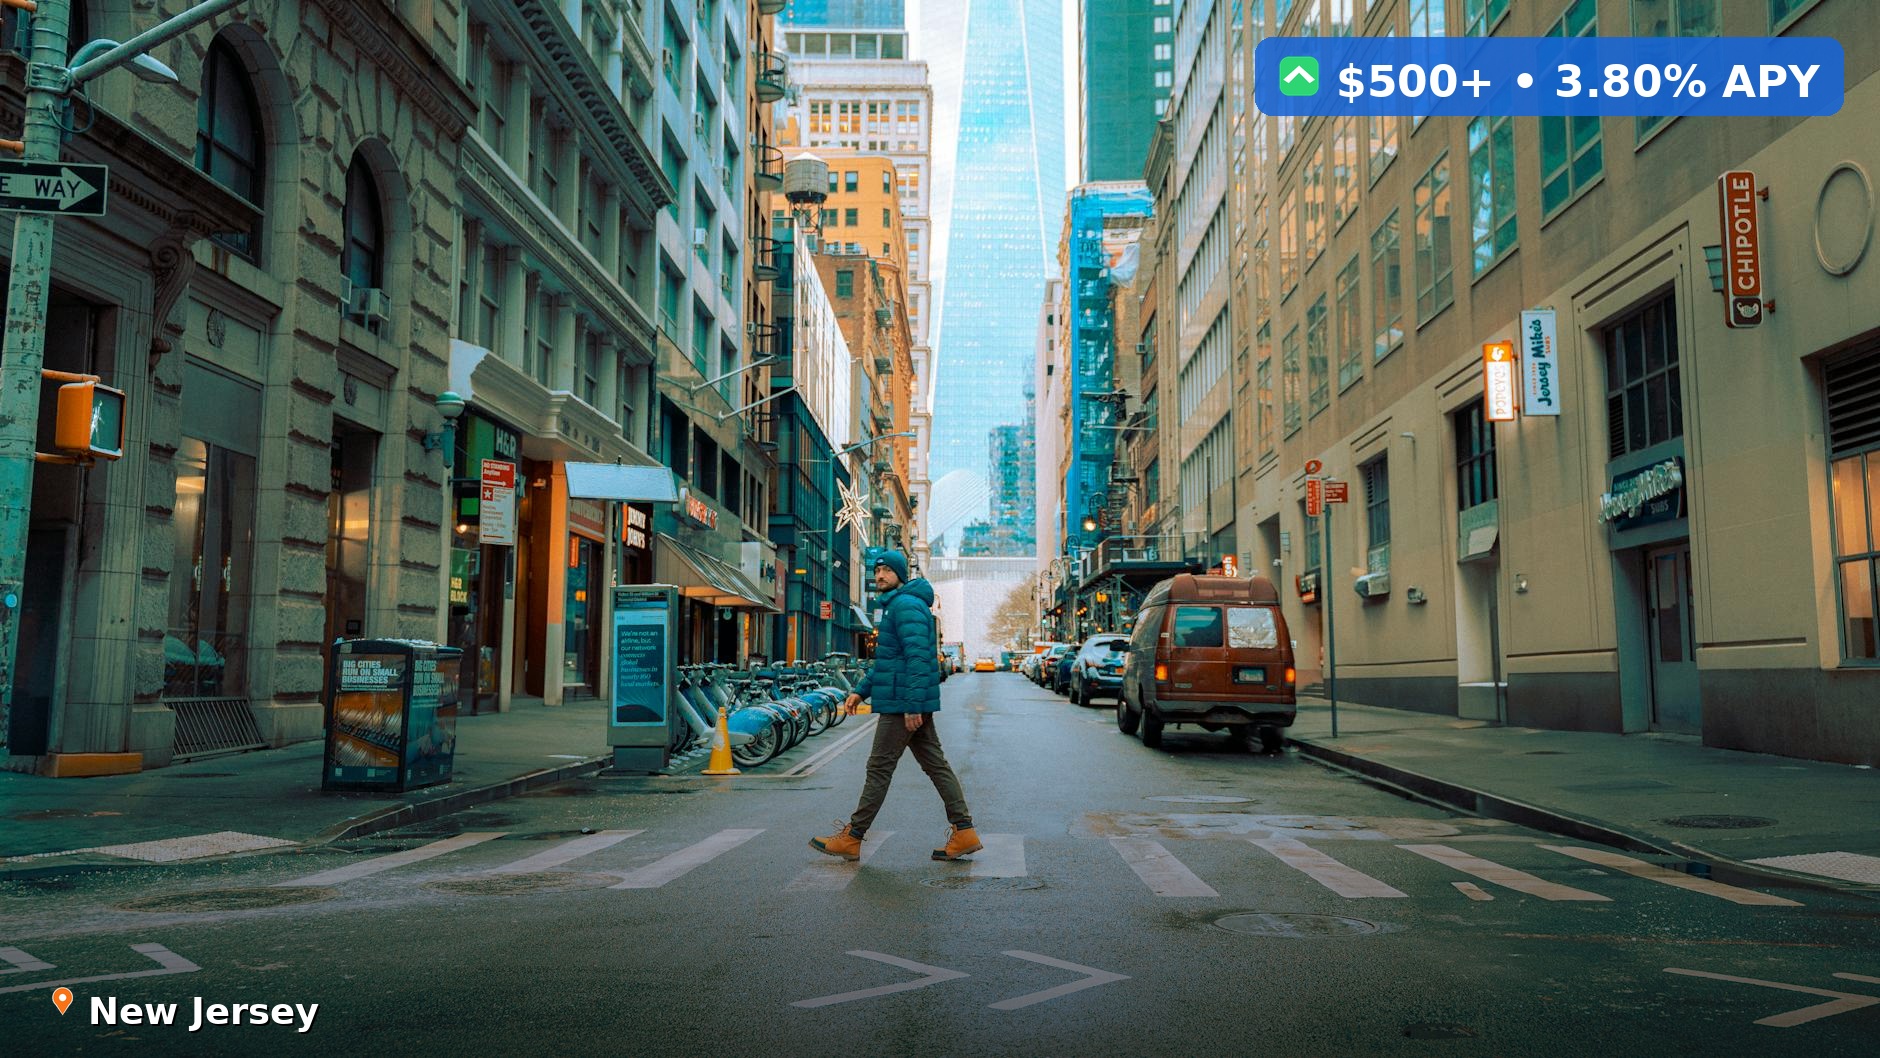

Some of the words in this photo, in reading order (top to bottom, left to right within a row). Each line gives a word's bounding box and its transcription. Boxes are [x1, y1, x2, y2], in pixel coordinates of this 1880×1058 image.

[35, 178, 81, 198] WAY
[1733, 177, 1755, 290] CHIPOTLE
[1529, 319, 1546, 358] Mike's
[1538, 362, 1552, 406] Jersey
[496, 427, 517, 459] H&R
[341, 676, 389, 684] BUSINESSES
[342, 668, 359, 676] RUN
[360, 668, 372, 676] ON
[372, 668, 398, 676] SMALL
